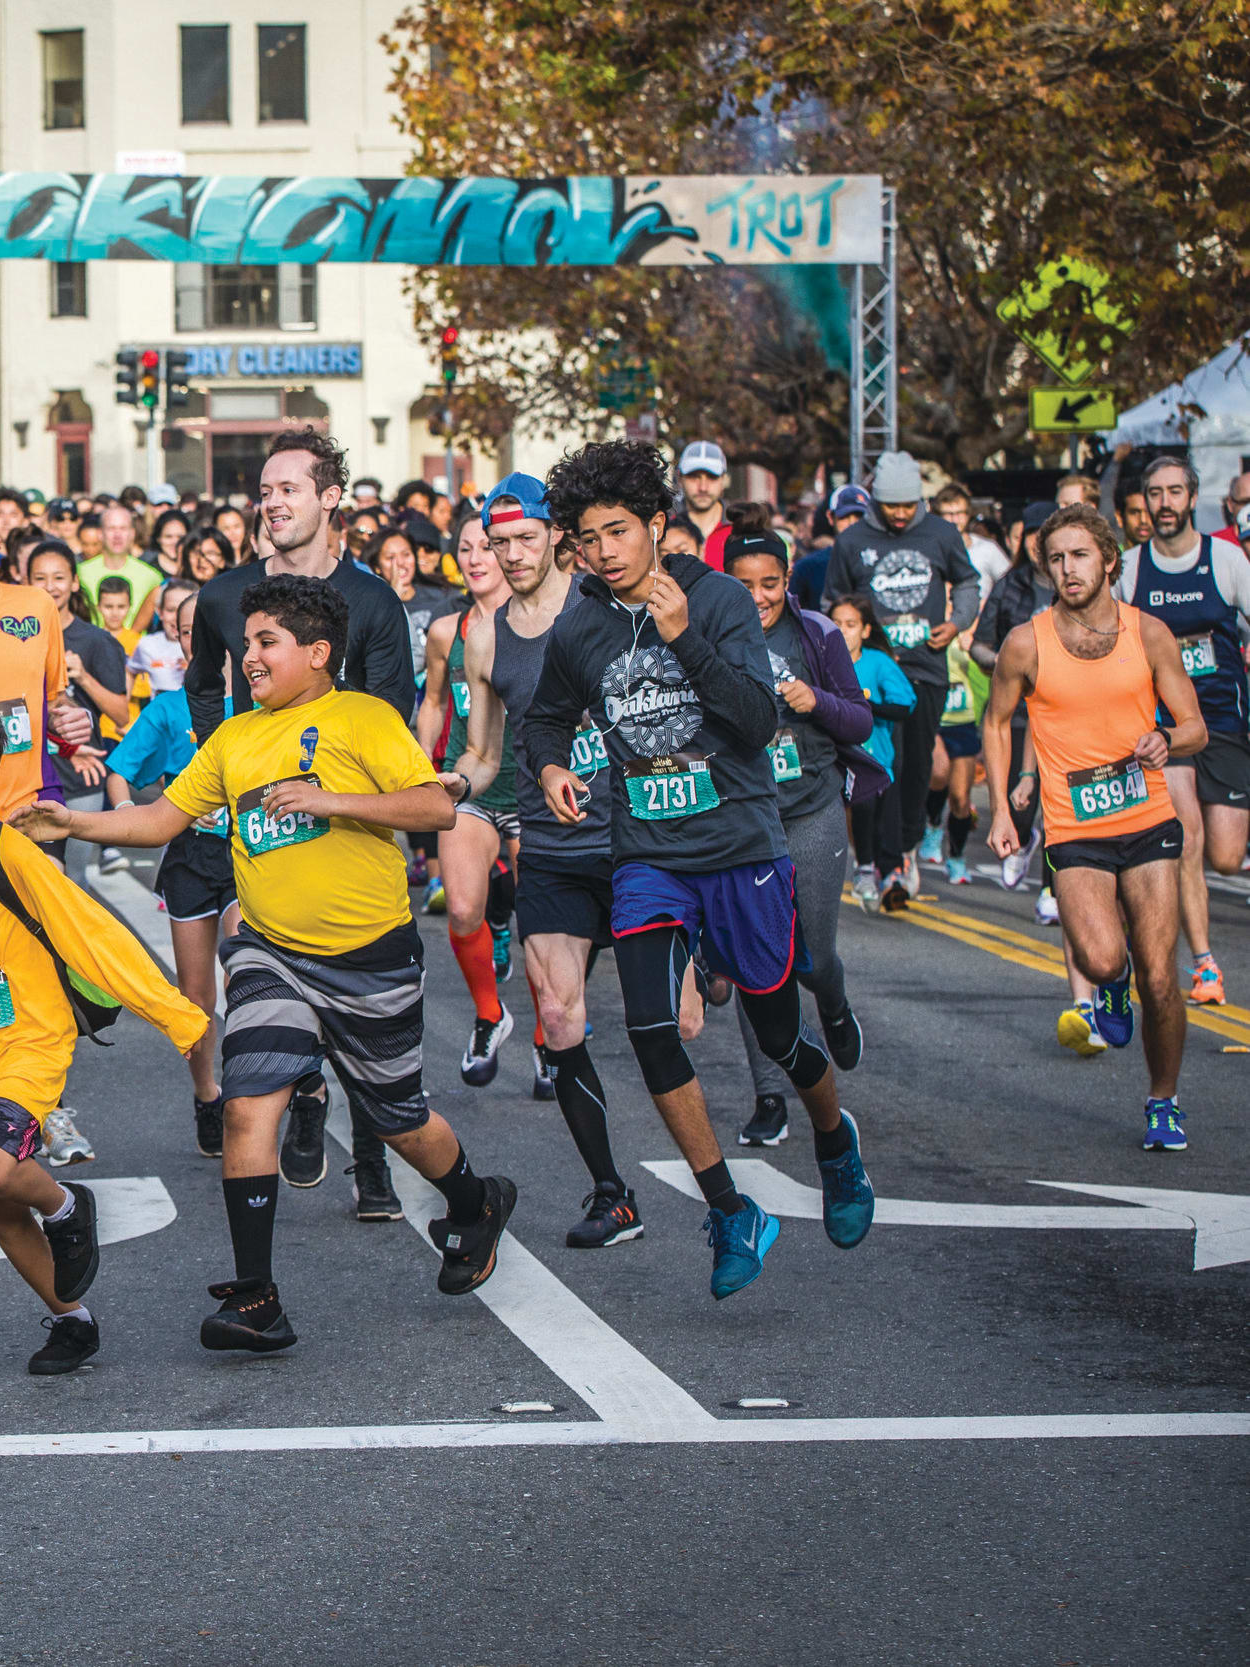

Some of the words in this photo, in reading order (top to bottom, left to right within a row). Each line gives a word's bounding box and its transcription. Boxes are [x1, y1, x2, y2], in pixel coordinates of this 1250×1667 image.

[705, 177, 846, 257] TROT
[237, 344, 362, 376] CLEANERS
[1165, 591, 1203, 605] Square
[643, 775, 698, 810] 2737
[1080, 774, 1138, 813] 6394
